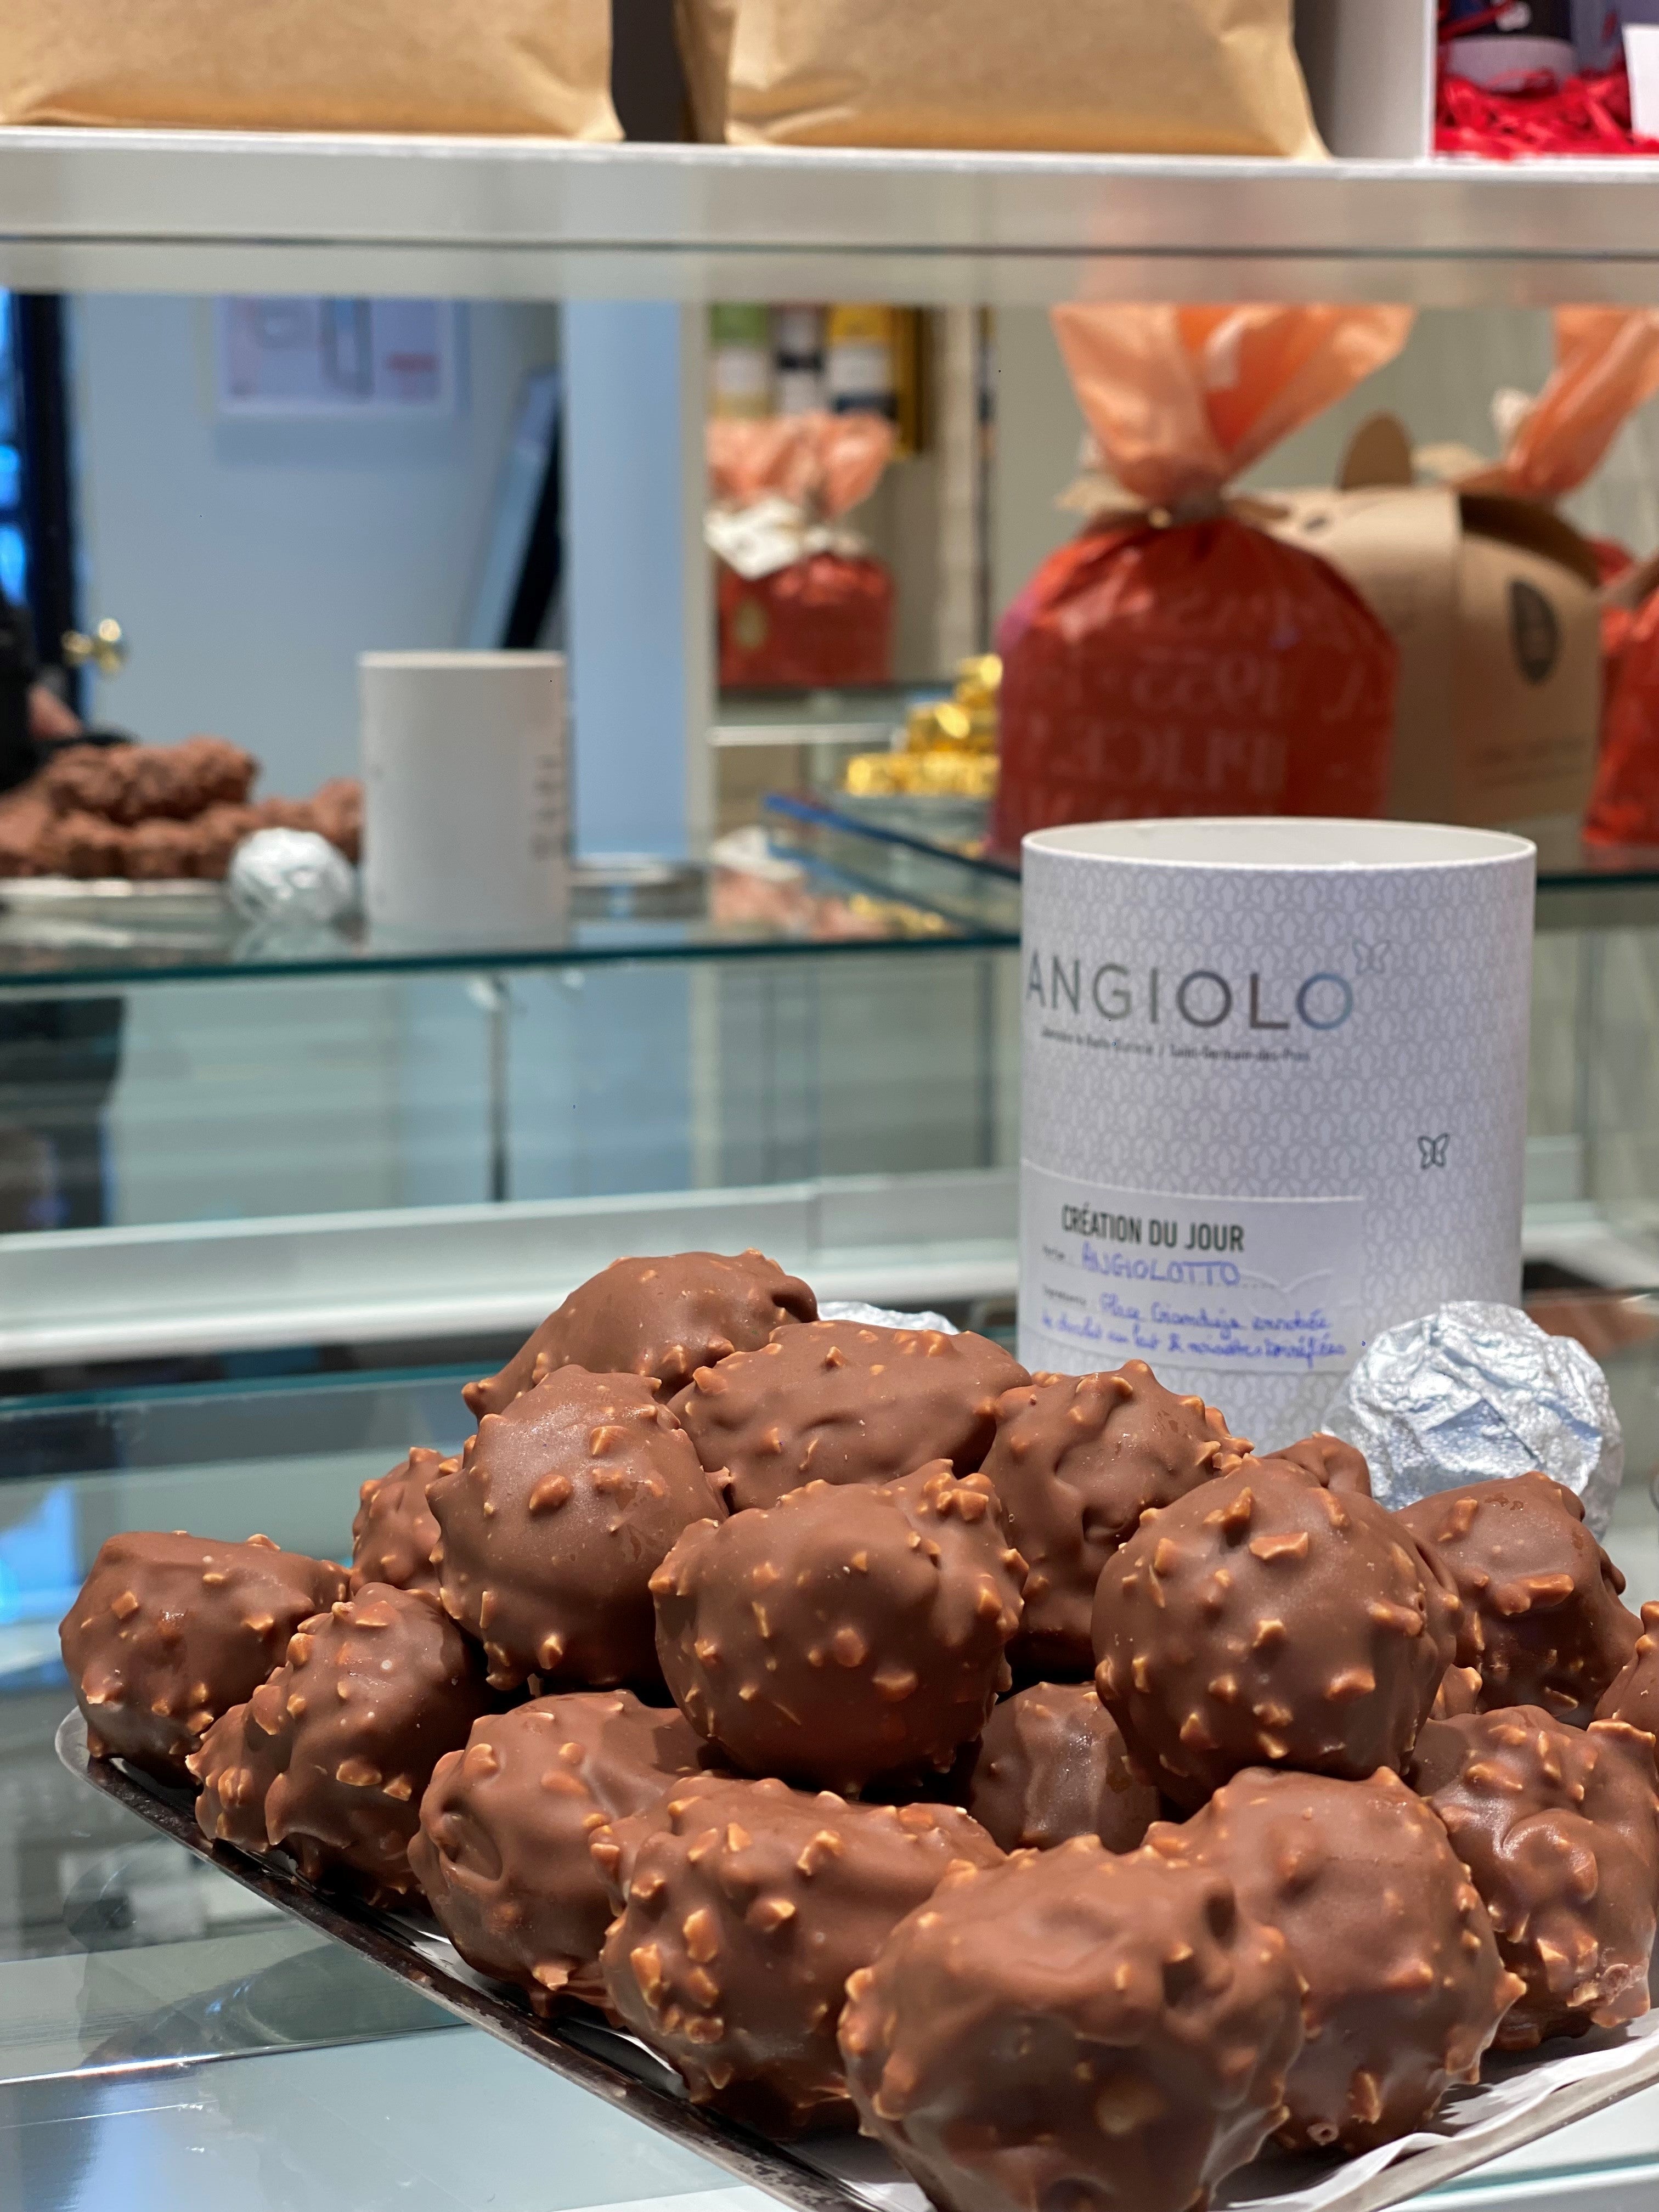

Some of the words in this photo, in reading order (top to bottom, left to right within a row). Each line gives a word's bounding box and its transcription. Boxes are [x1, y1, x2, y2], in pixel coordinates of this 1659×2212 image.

[1025, 949, 1353, 1030] ANGIOLO
[1062, 1202, 1142, 1244] CRÉATION
[1149, 1220, 1178, 1248] DU
[1185, 1222, 1244, 1251] JOUR
[1081, 1240, 1240, 1286] ANGIOLOTTO
